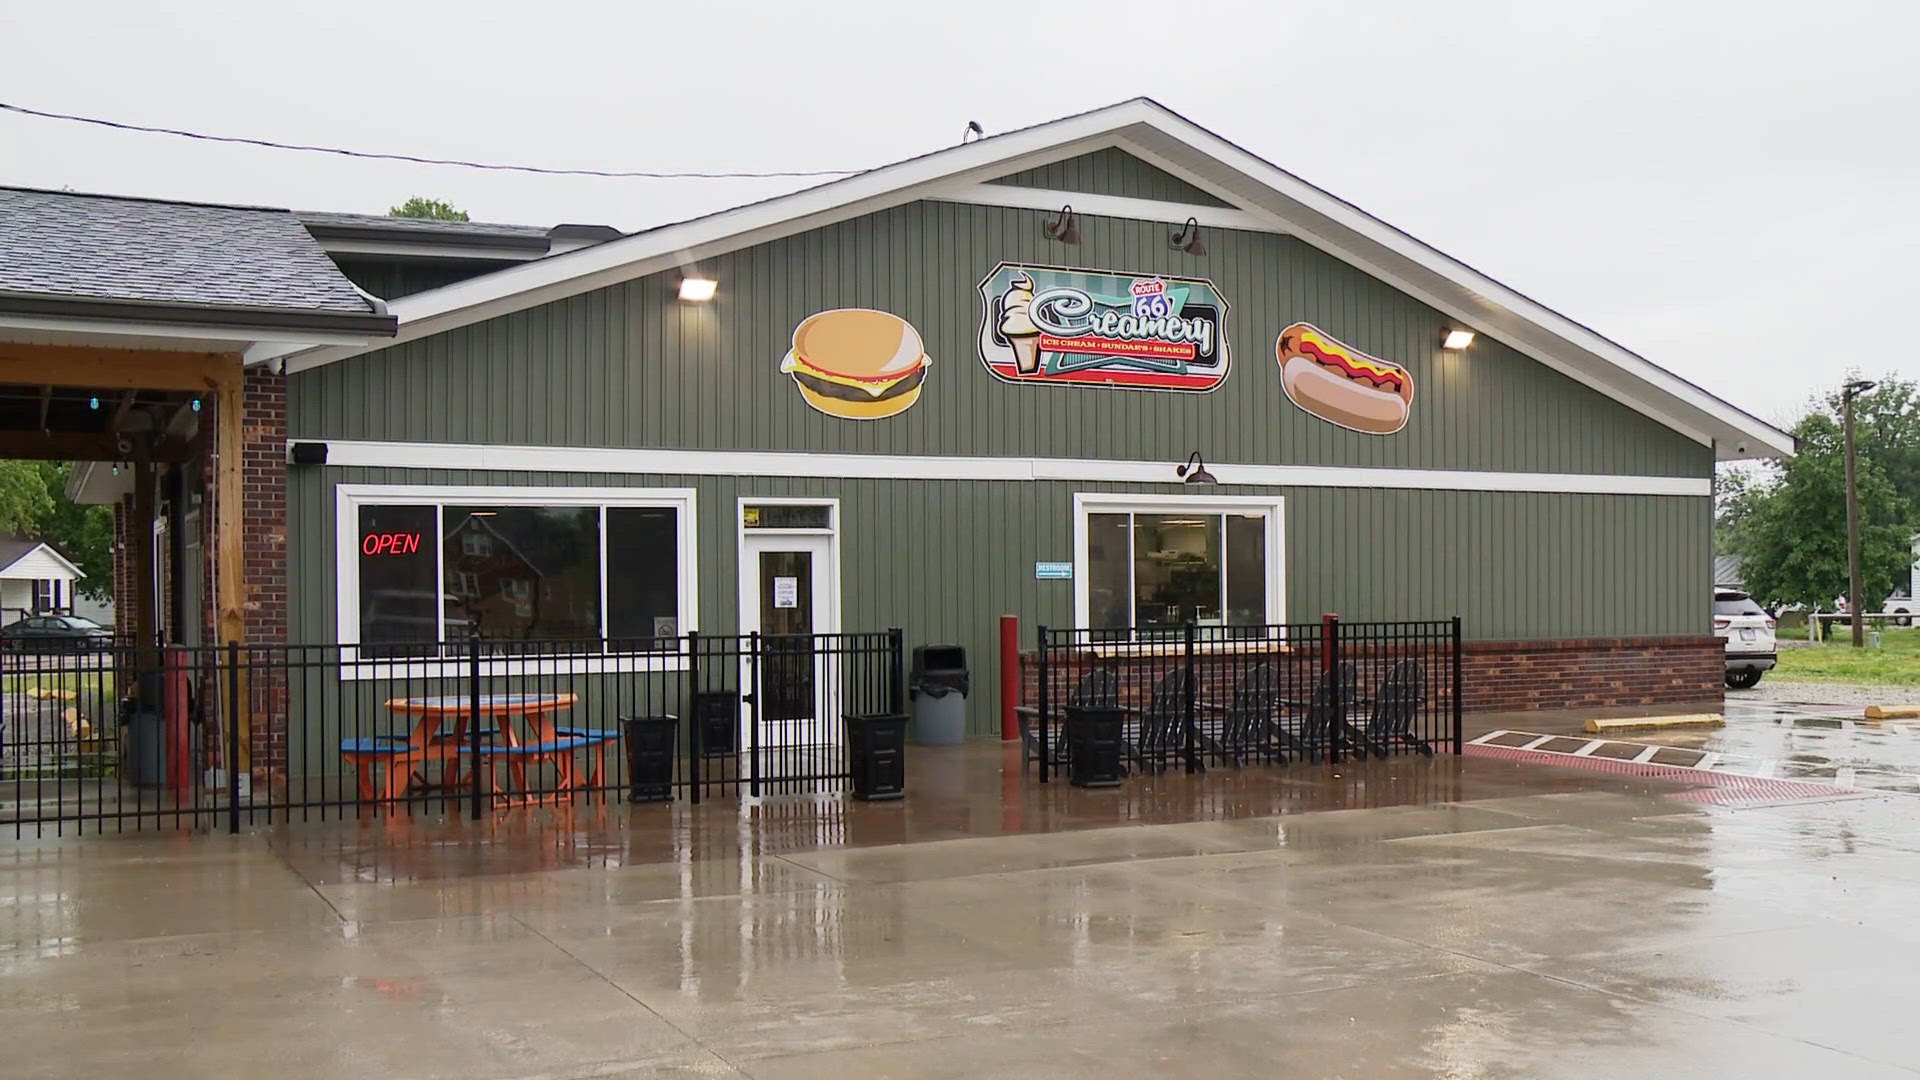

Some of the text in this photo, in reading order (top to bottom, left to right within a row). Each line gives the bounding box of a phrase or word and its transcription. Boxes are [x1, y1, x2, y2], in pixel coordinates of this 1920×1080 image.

[1135, 283, 1161, 294] ROUTE
[1136, 296, 1165, 318] 66
[1028, 288, 1212, 356] Creamery
[1060, 339, 1096, 348] CREAM
[1153, 346, 1191, 355] SHAKES
[363, 532, 421, 556] OPEN
